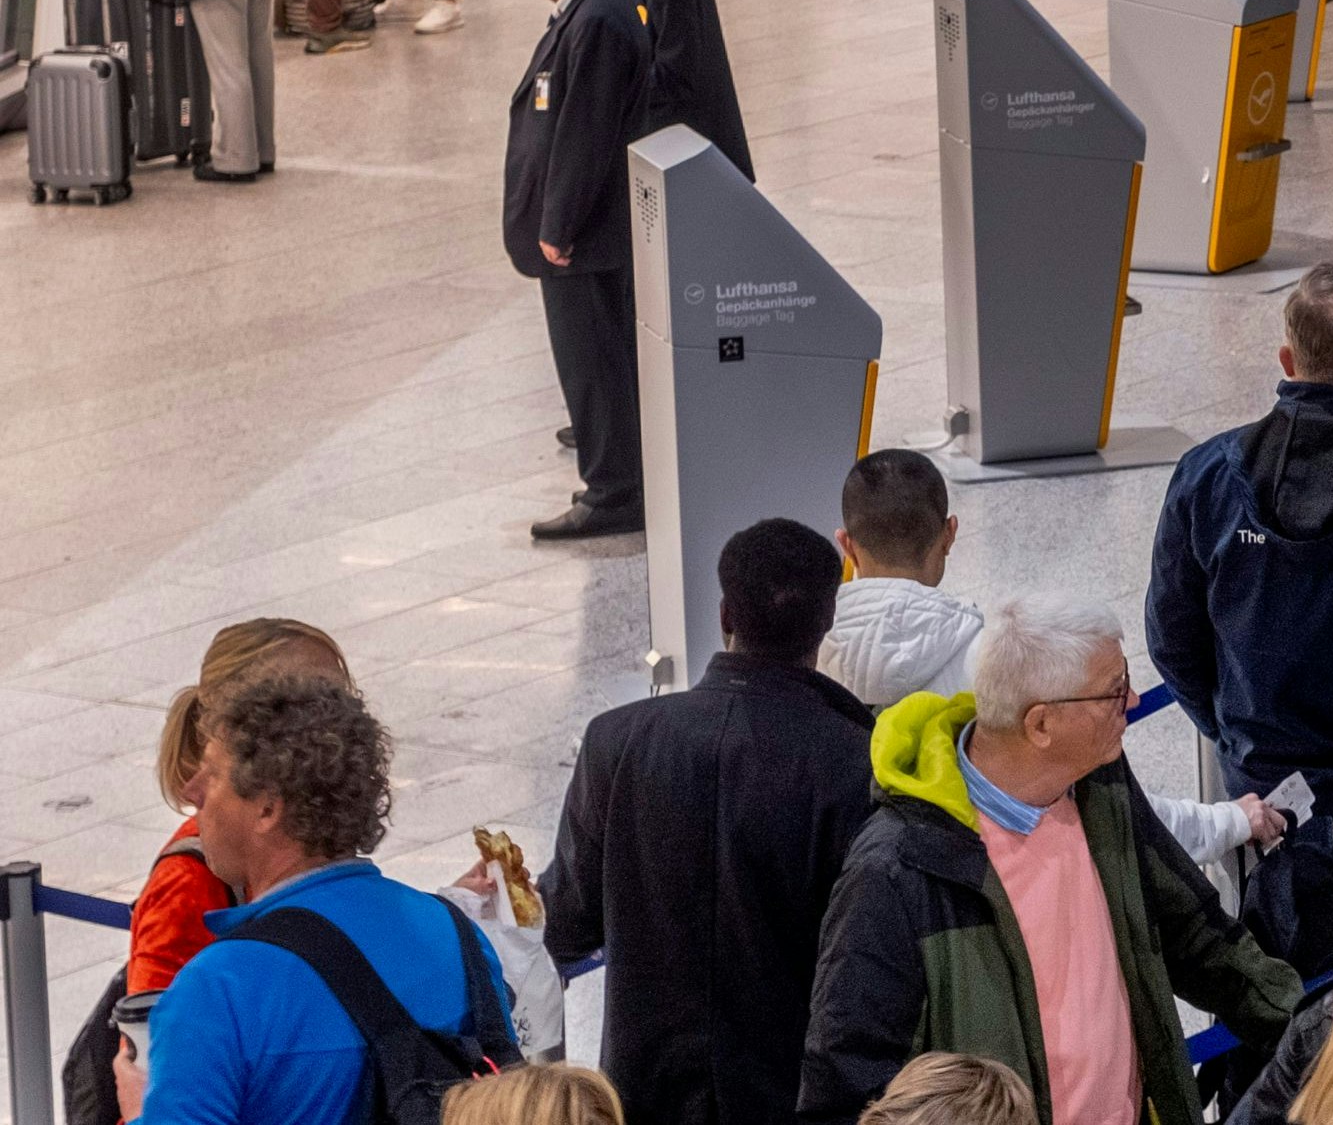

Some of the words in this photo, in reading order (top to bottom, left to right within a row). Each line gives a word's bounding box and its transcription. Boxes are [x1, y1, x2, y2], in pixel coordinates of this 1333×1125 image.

[1007, 90, 1076, 106] Lufthansa
[1007, 102, 1097, 118] Gepäckanhänger
[716, 281, 798, 299] Lufthansa
[716, 313, 771, 328] Baggage
[775, 309, 795, 323] Tag
[1237, 529, 1266, 544] The
